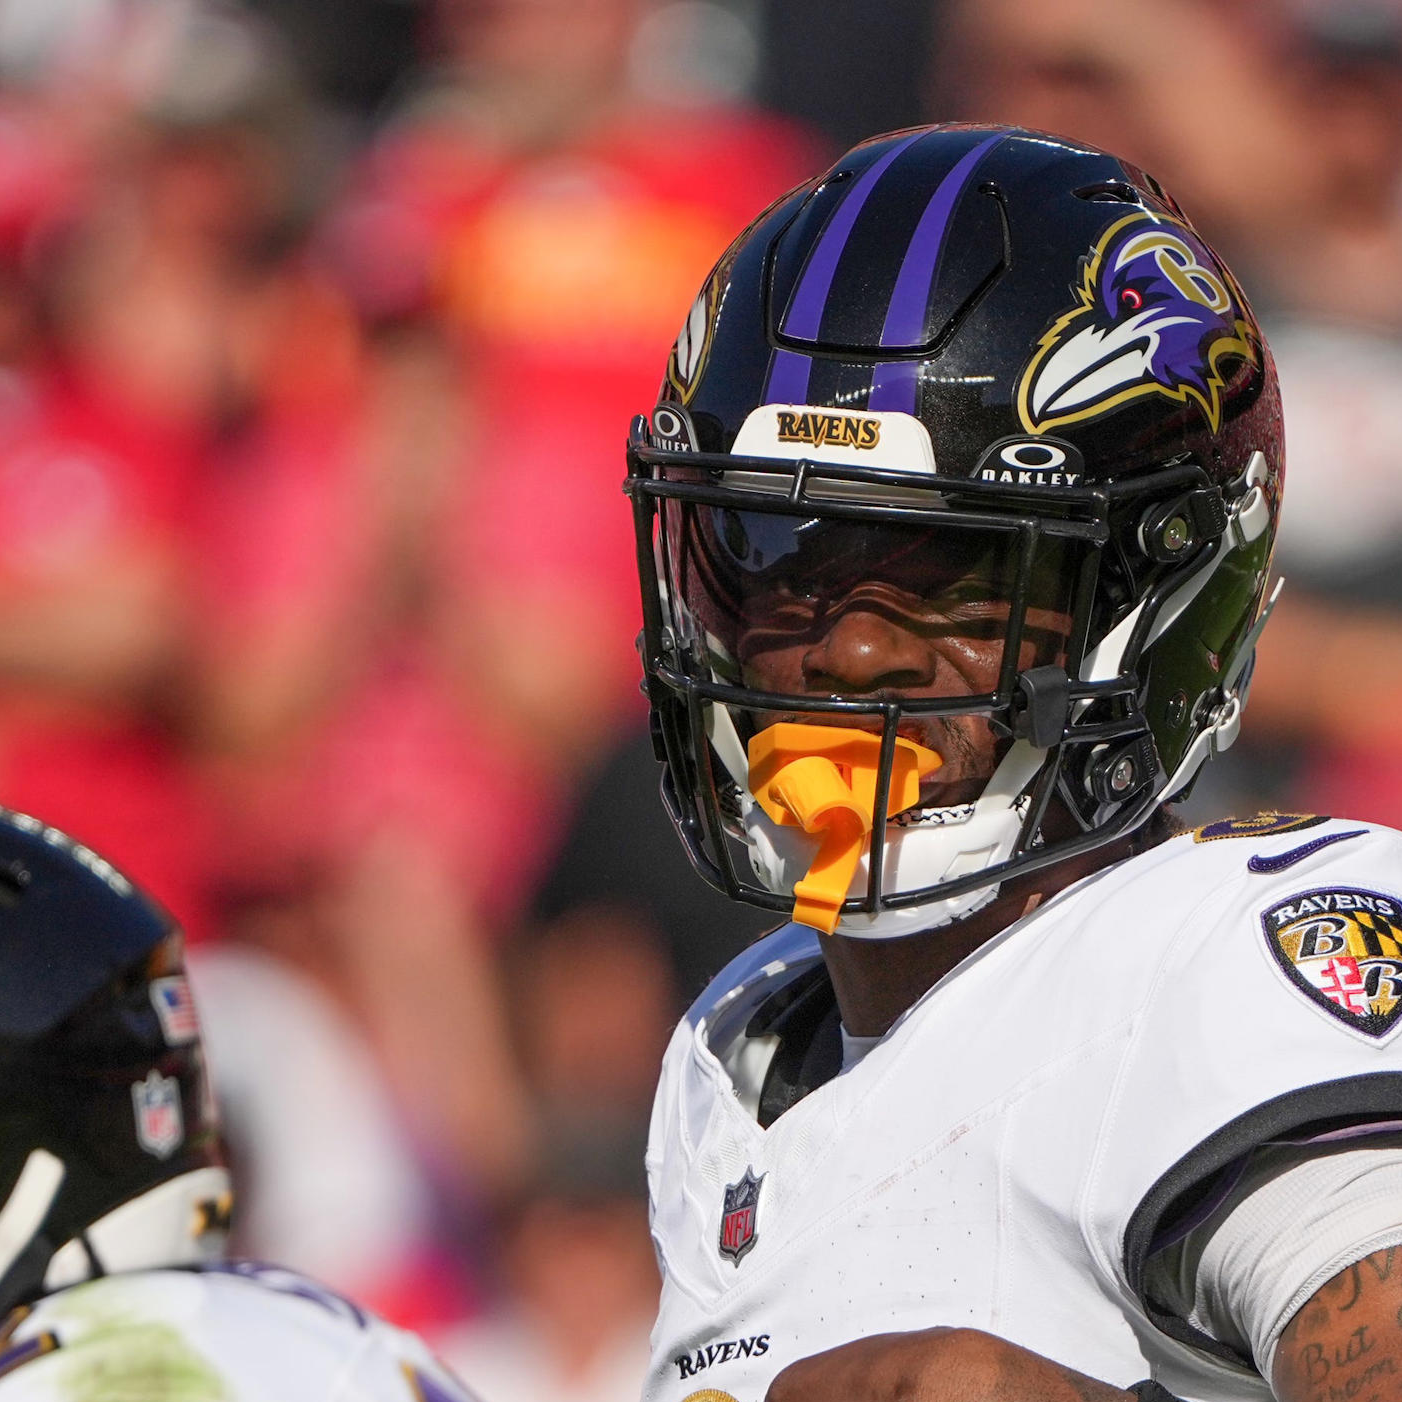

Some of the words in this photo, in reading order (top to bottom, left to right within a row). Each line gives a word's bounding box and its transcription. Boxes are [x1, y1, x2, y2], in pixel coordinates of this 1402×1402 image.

[1114, 231, 1231, 316] B
[777, 411, 881, 449] RAVENS
[981, 469, 1078, 488] OAKLEY
[1271, 894, 1395, 925] RAVENS
[1279, 915, 1348, 961] B
[721, 1207, 753, 1248] NFL
[674, 1334, 771, 1380] RAVENS
